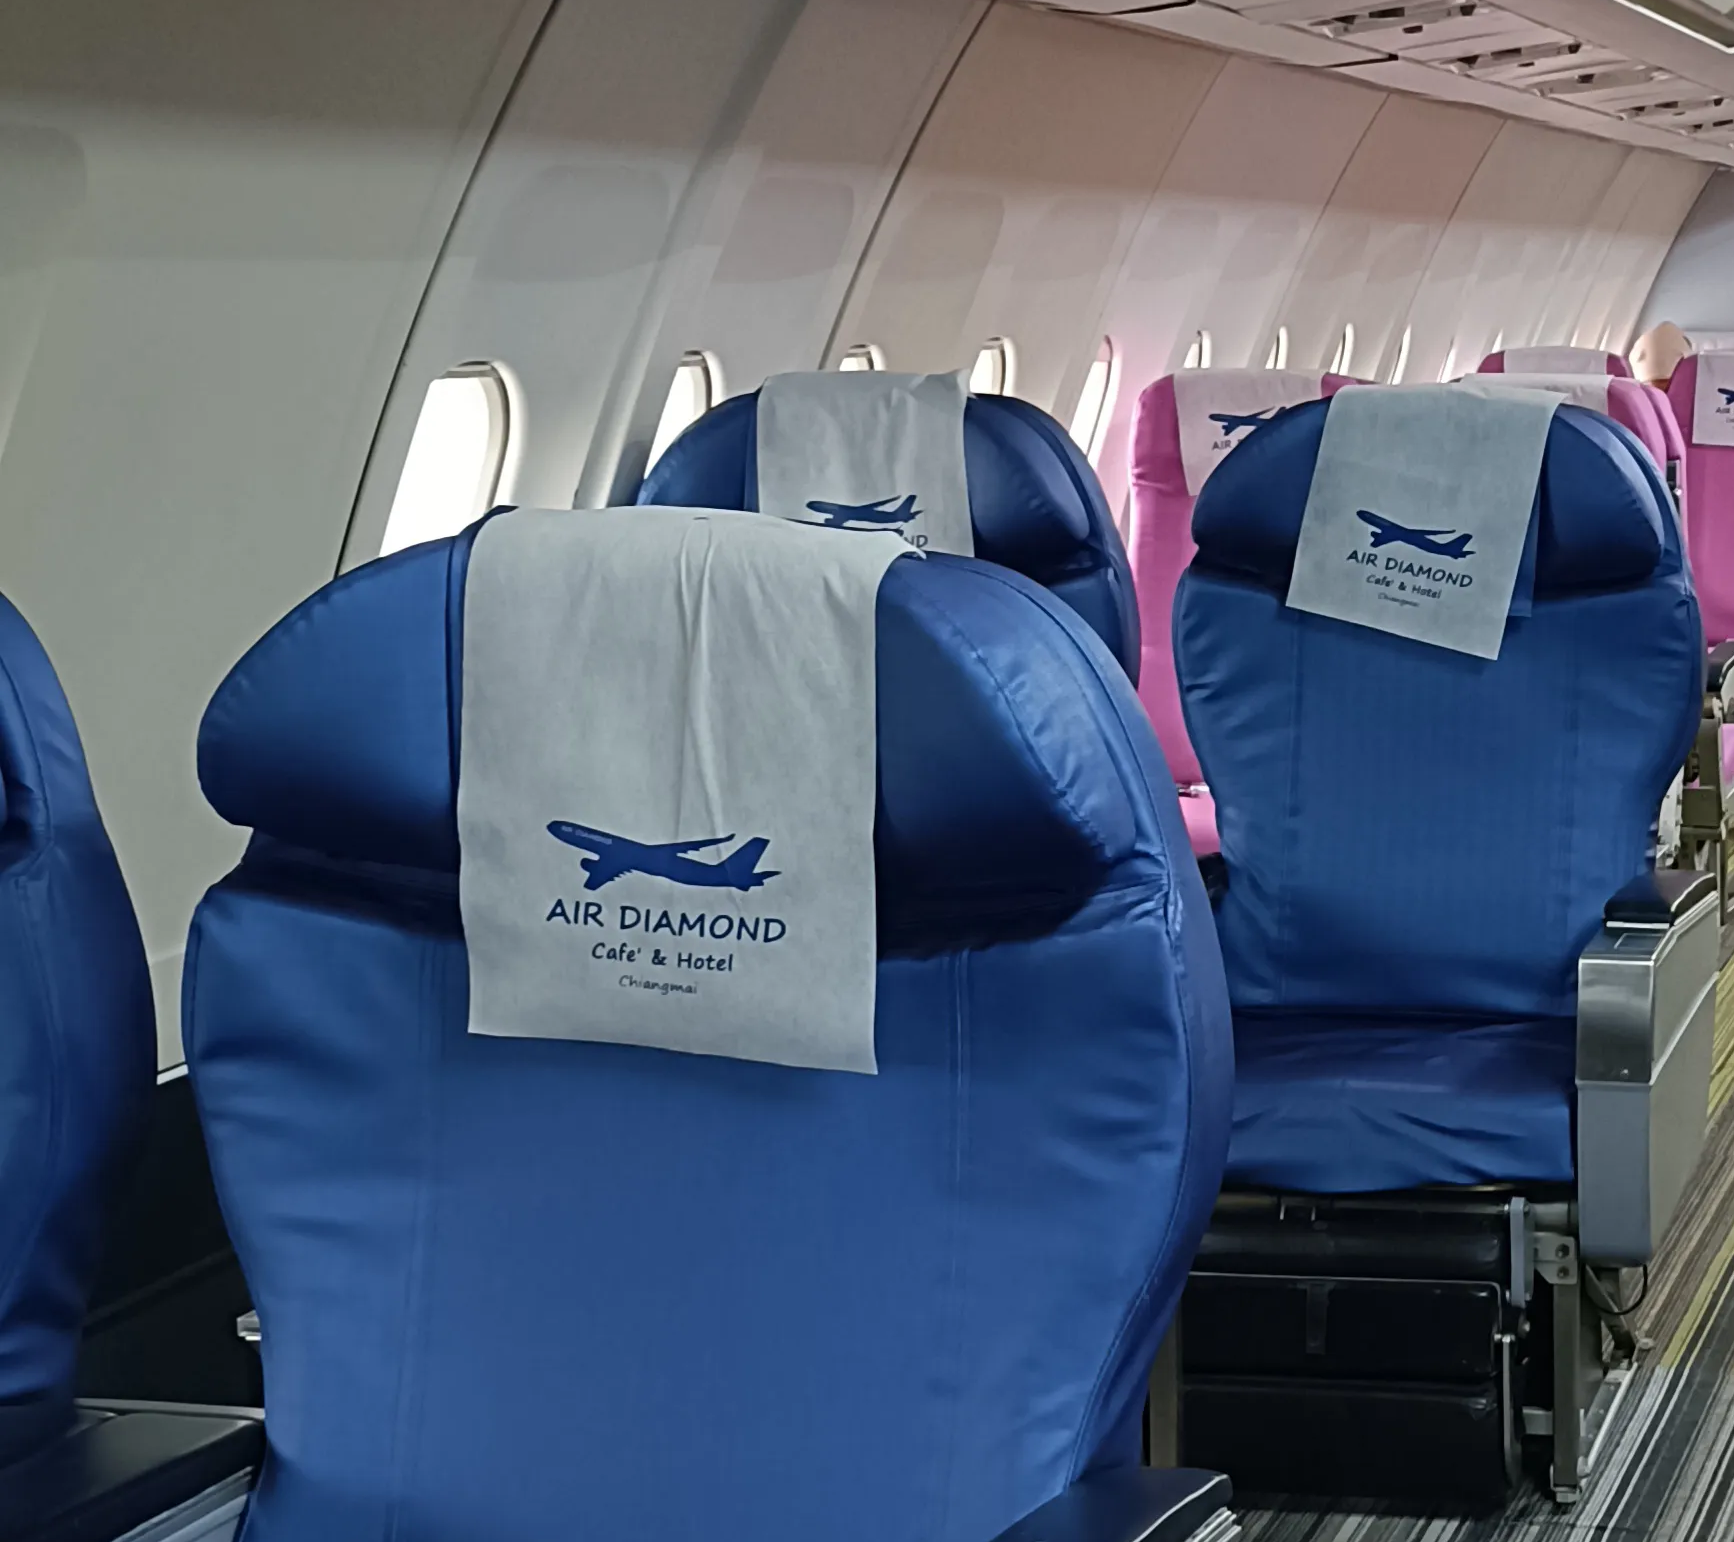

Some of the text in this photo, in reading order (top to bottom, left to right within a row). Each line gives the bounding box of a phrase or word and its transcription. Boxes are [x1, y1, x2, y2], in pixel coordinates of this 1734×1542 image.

[1212, 439, 1231, 450] AIR
[1346, 550, 1473, 588] AIR DIAMOND
[546, 898, 787, 943] AIR DIAMOND
[651, 948, 667, 966] &
[677, 952, 733, 972] Hotel
[618, 975, 698, 996] Chiangmai
